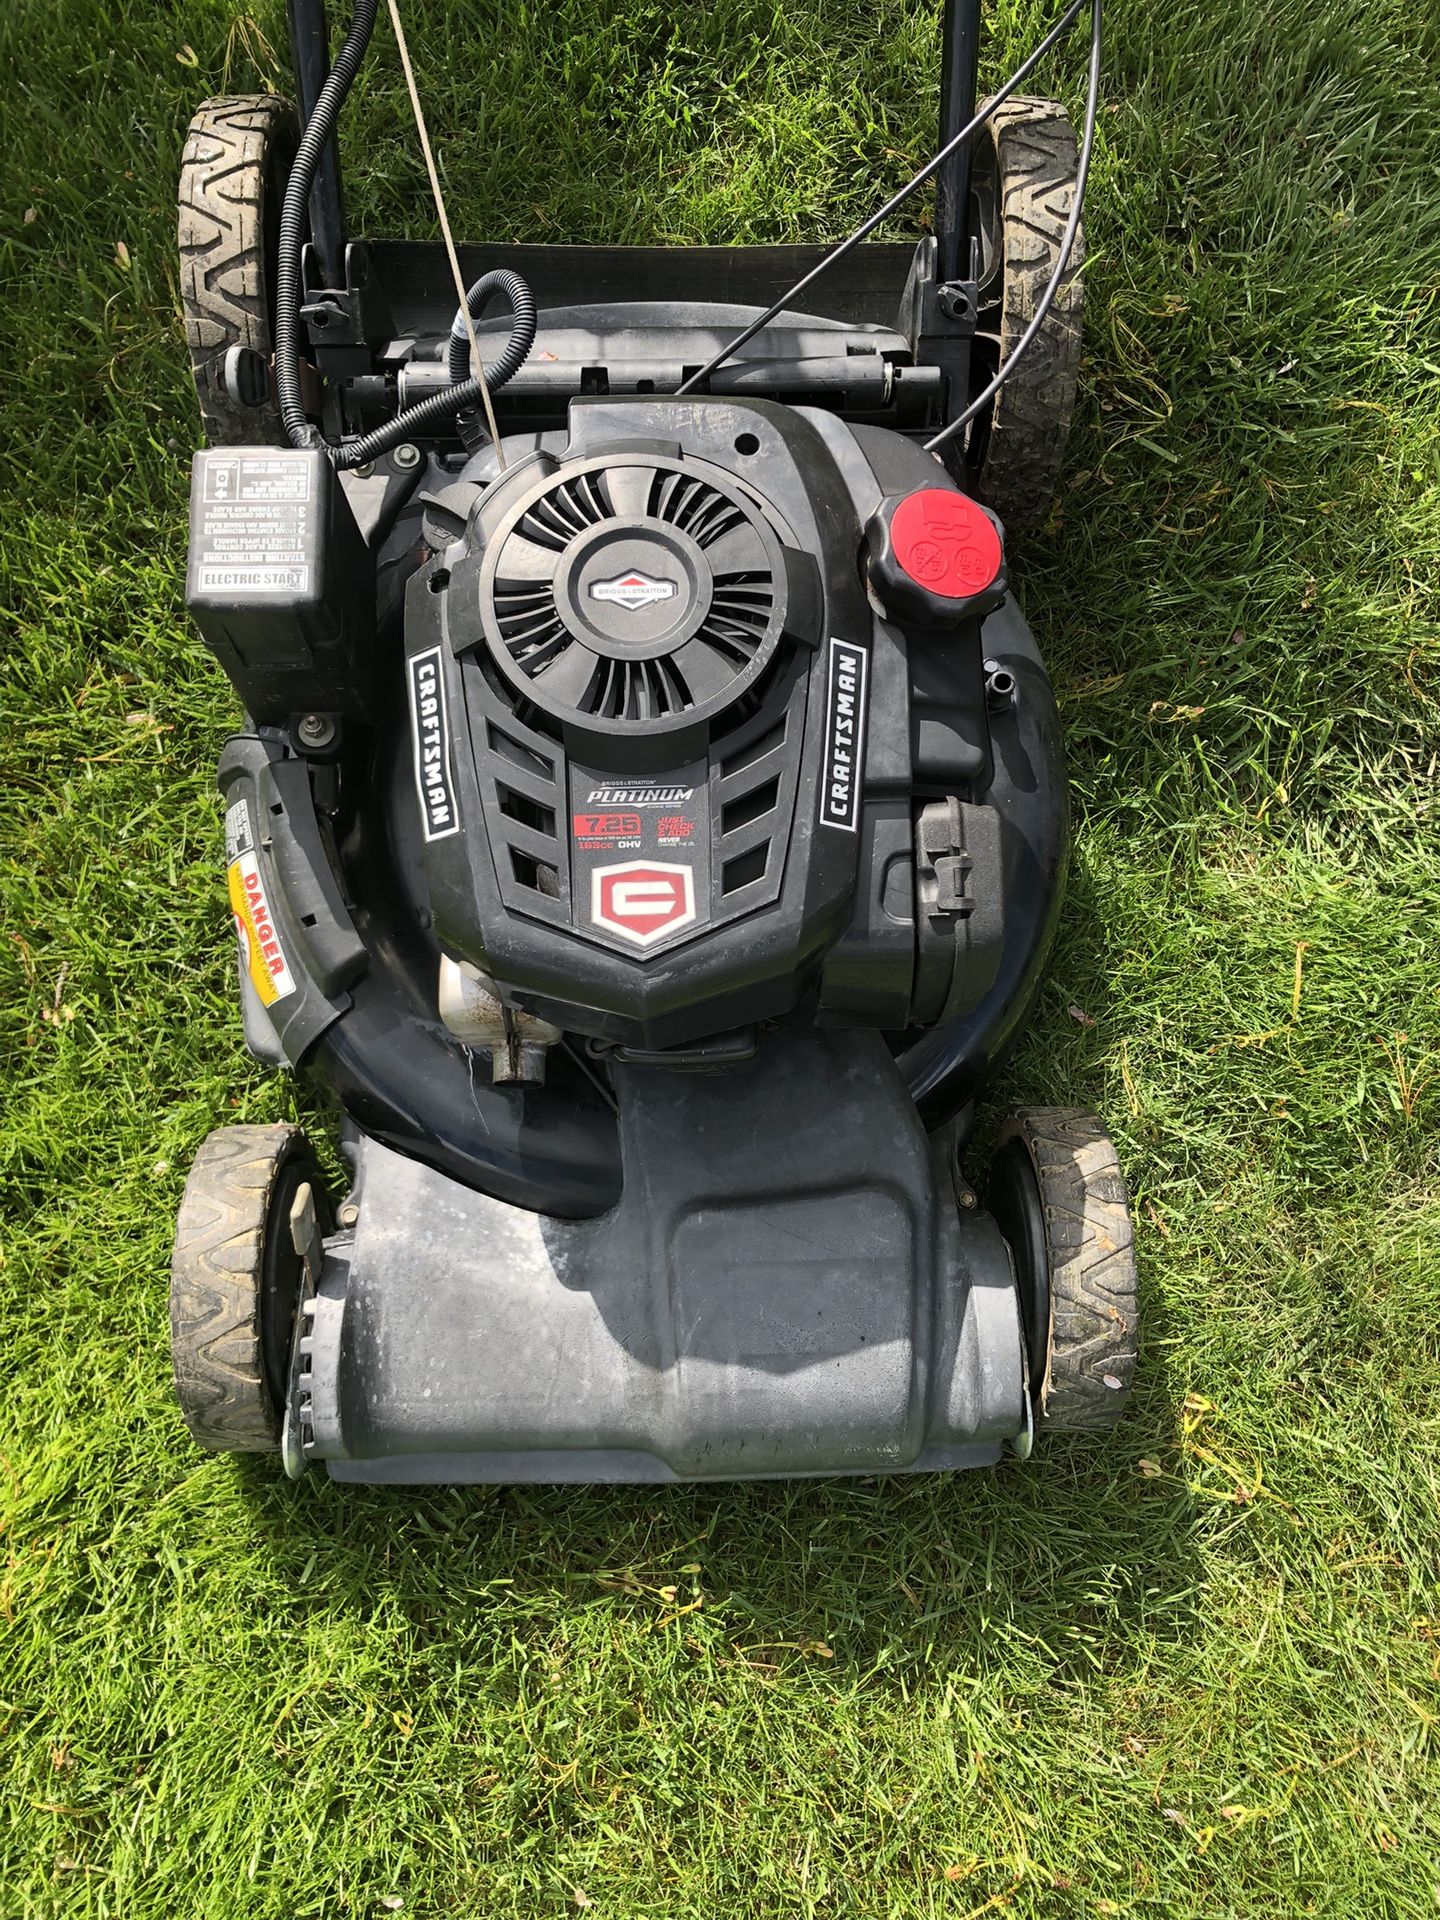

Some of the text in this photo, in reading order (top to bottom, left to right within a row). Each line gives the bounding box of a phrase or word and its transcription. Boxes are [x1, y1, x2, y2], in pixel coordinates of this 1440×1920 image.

[298, 506, 306, 518] 3
[298, 522, 306, 534] 2
[297, 538, 304, 550] 1
[203, 553, 263, 562] INSTRUCTIONS
[205, 573, 302, 585] ELECTRIC START
[830, 654, 857, 817] CRAFTSMAN
[418, 663, 450, 825] CRAFTSMAN
[586, 788, 694, 803] PLATINUM
[585, 816, 638, 833] 7.25
[658, 815, 686, 823] JUST
[657, 822, 695, 830] CHECK
[578, 840, 642, 850] 163cc OHV
[244, 871, 285, 976] DANGER
[240, 893, 252, 924] HANDS
[249, 927, 258, 943] and
[254, 944, 266, 966] FEET
[262, 969, 276, 995] AWAY
